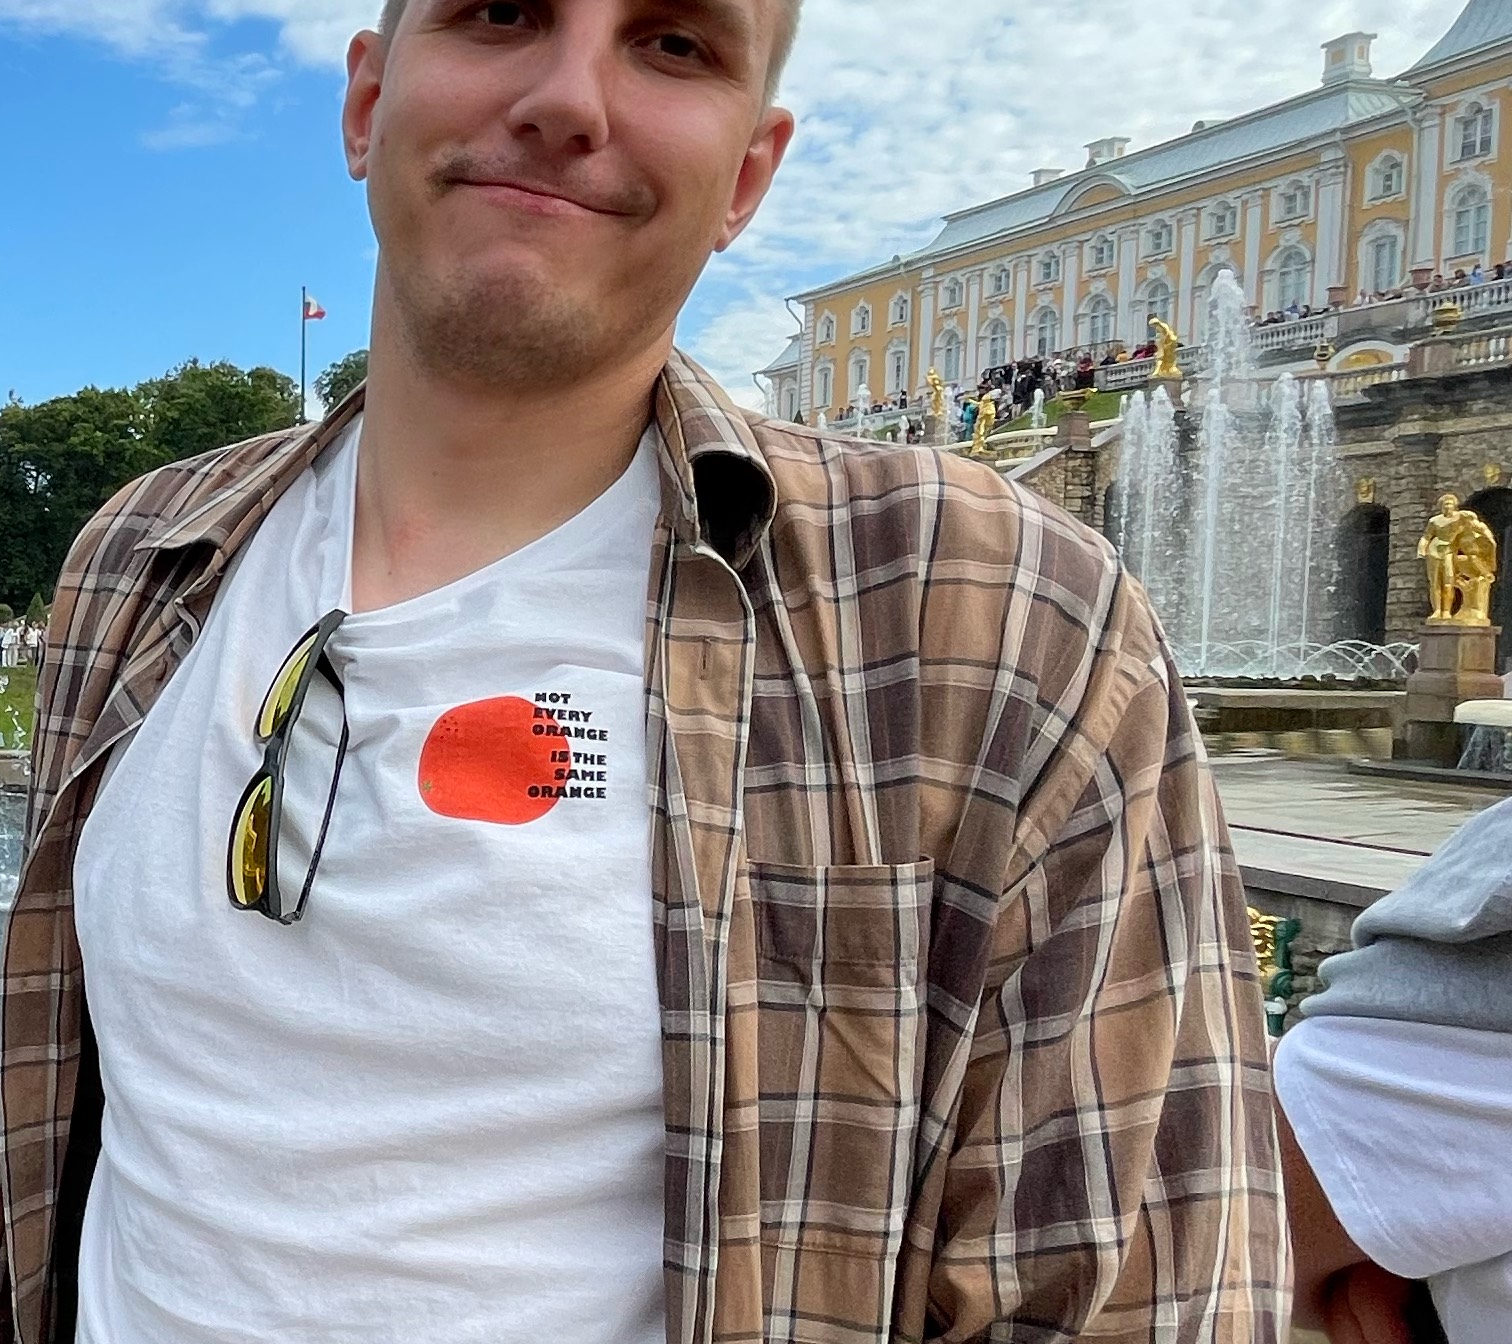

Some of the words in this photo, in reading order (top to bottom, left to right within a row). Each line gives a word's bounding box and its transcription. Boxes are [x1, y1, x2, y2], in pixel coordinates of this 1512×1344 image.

[534, 692, 571, 704] NOT
[533, 707, 593, 722] EVERY
[532, 724, 608, 741] ORANGE
[550, 750, 570, 763] IS
[573, 751, 607, 766] THE
[554, 768, 607, 782] SAME
[527, 785, 607, 799] ORANGE
